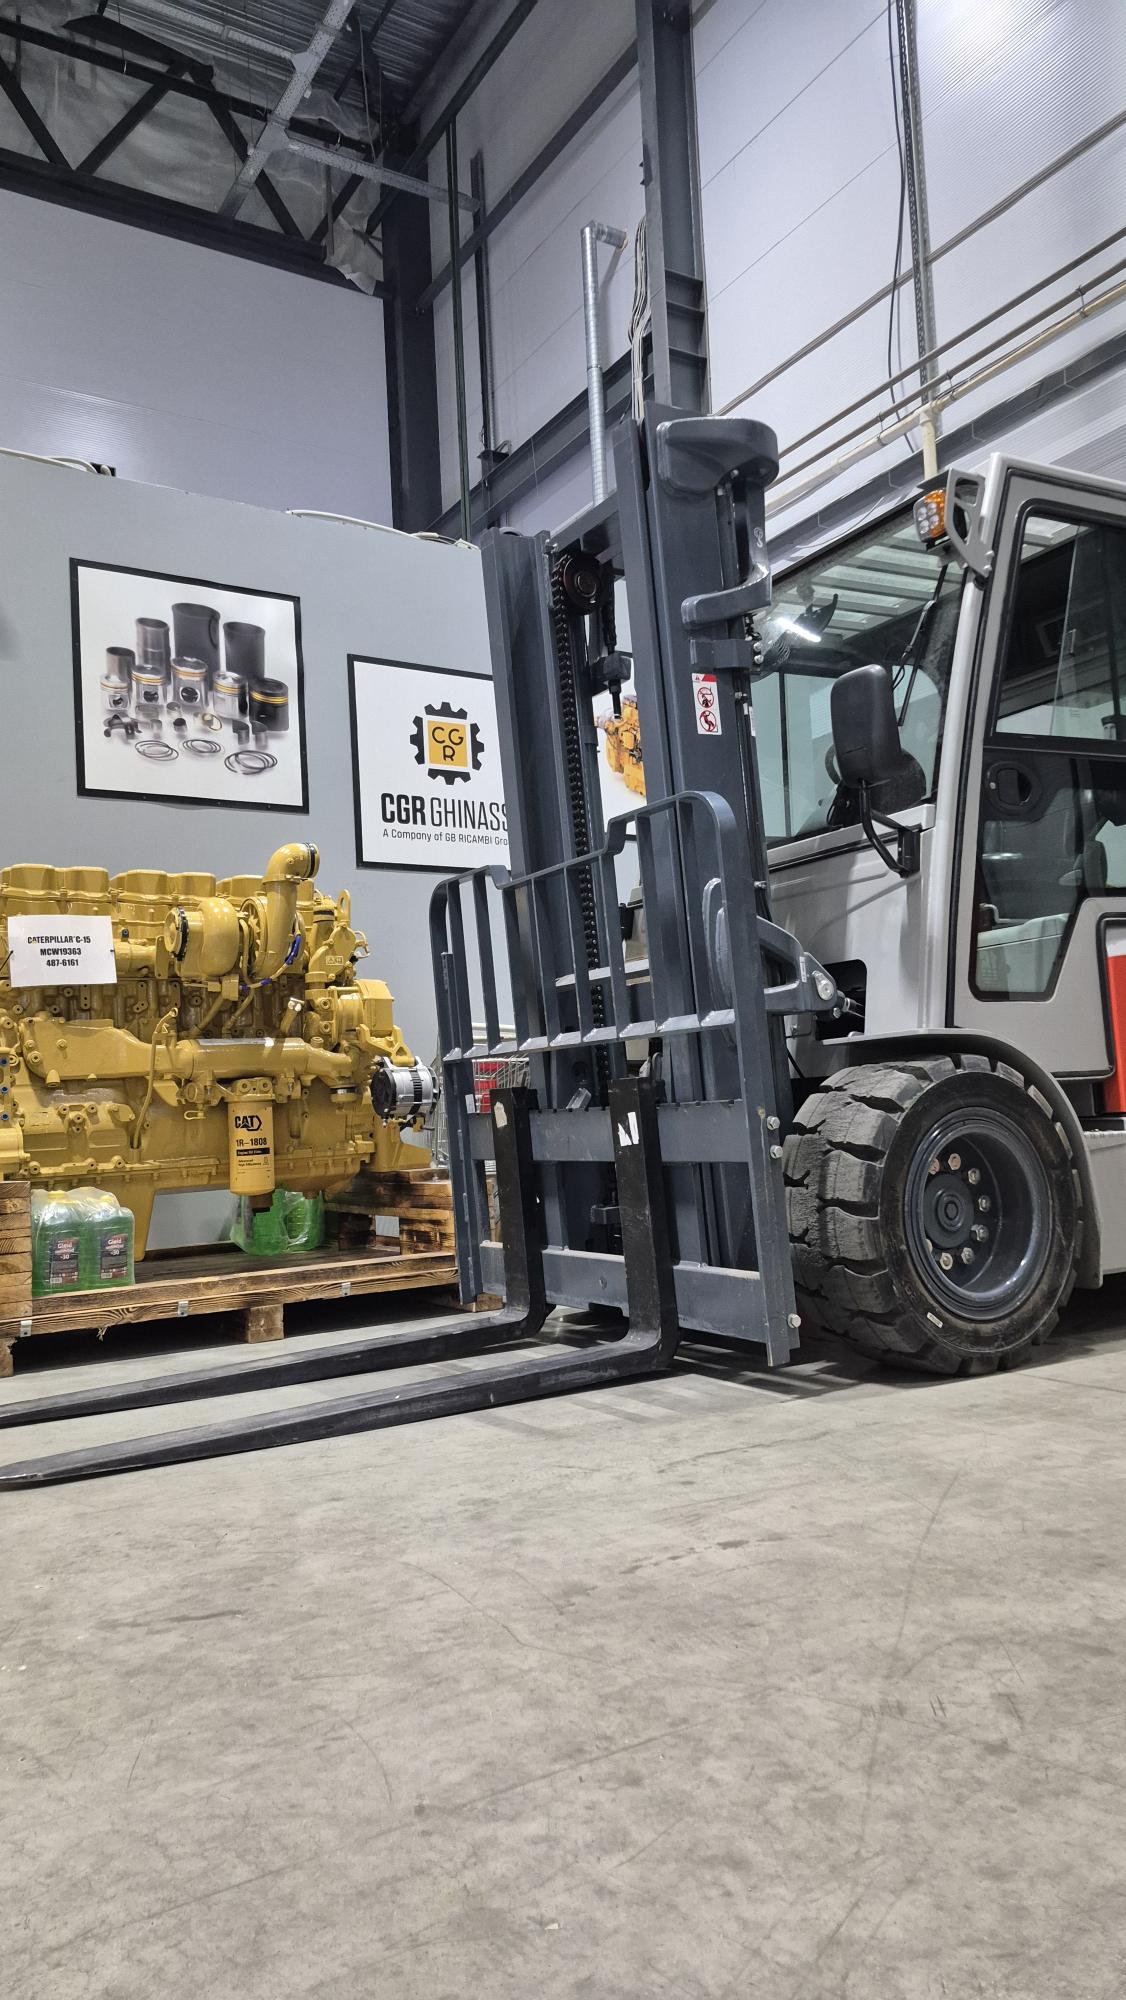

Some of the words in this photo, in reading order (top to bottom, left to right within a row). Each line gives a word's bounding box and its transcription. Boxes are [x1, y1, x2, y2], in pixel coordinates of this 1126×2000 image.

[381, 792, 426, 826] CGR
[383, 828, 389, 838] A
[391, 829, 431, 842] Company
[434, 832, 443, 841] of
[445, 833, 456, 842] GB
[459, 834, 492, 845] RICAMBI
[28, 936, 73, 944] CATERPILLAR
[76, 936, 91, 944] C-15
[40, 948, 82, 956] MCW19363
[46, 959, 79, 967] 487-6161
[235, 1115, 259, 1130] CAT
